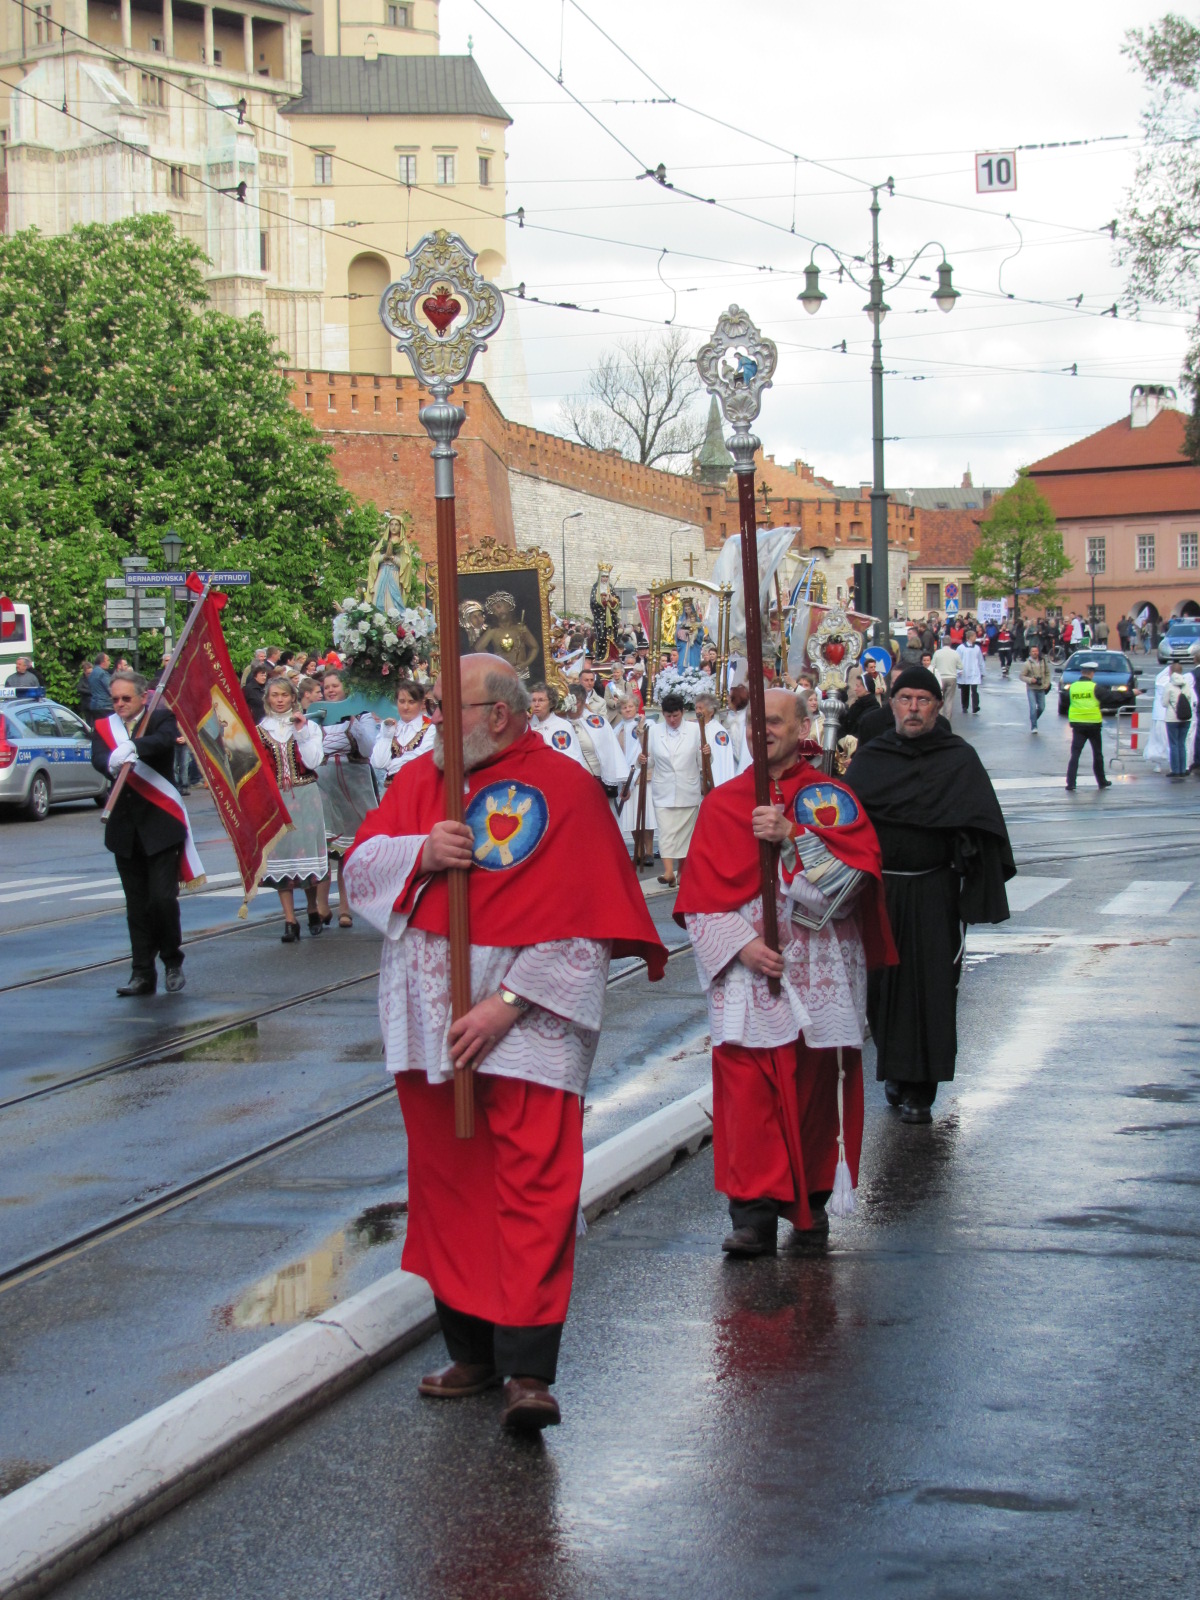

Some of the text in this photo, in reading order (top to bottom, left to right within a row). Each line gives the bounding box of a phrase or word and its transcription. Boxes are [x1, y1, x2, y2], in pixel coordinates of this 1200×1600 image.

[981, 158, 1011, 186] 10
[127, 573, 184, 582] BERNARDYŃSKA
[223, 799, 240, 828] NAMI
